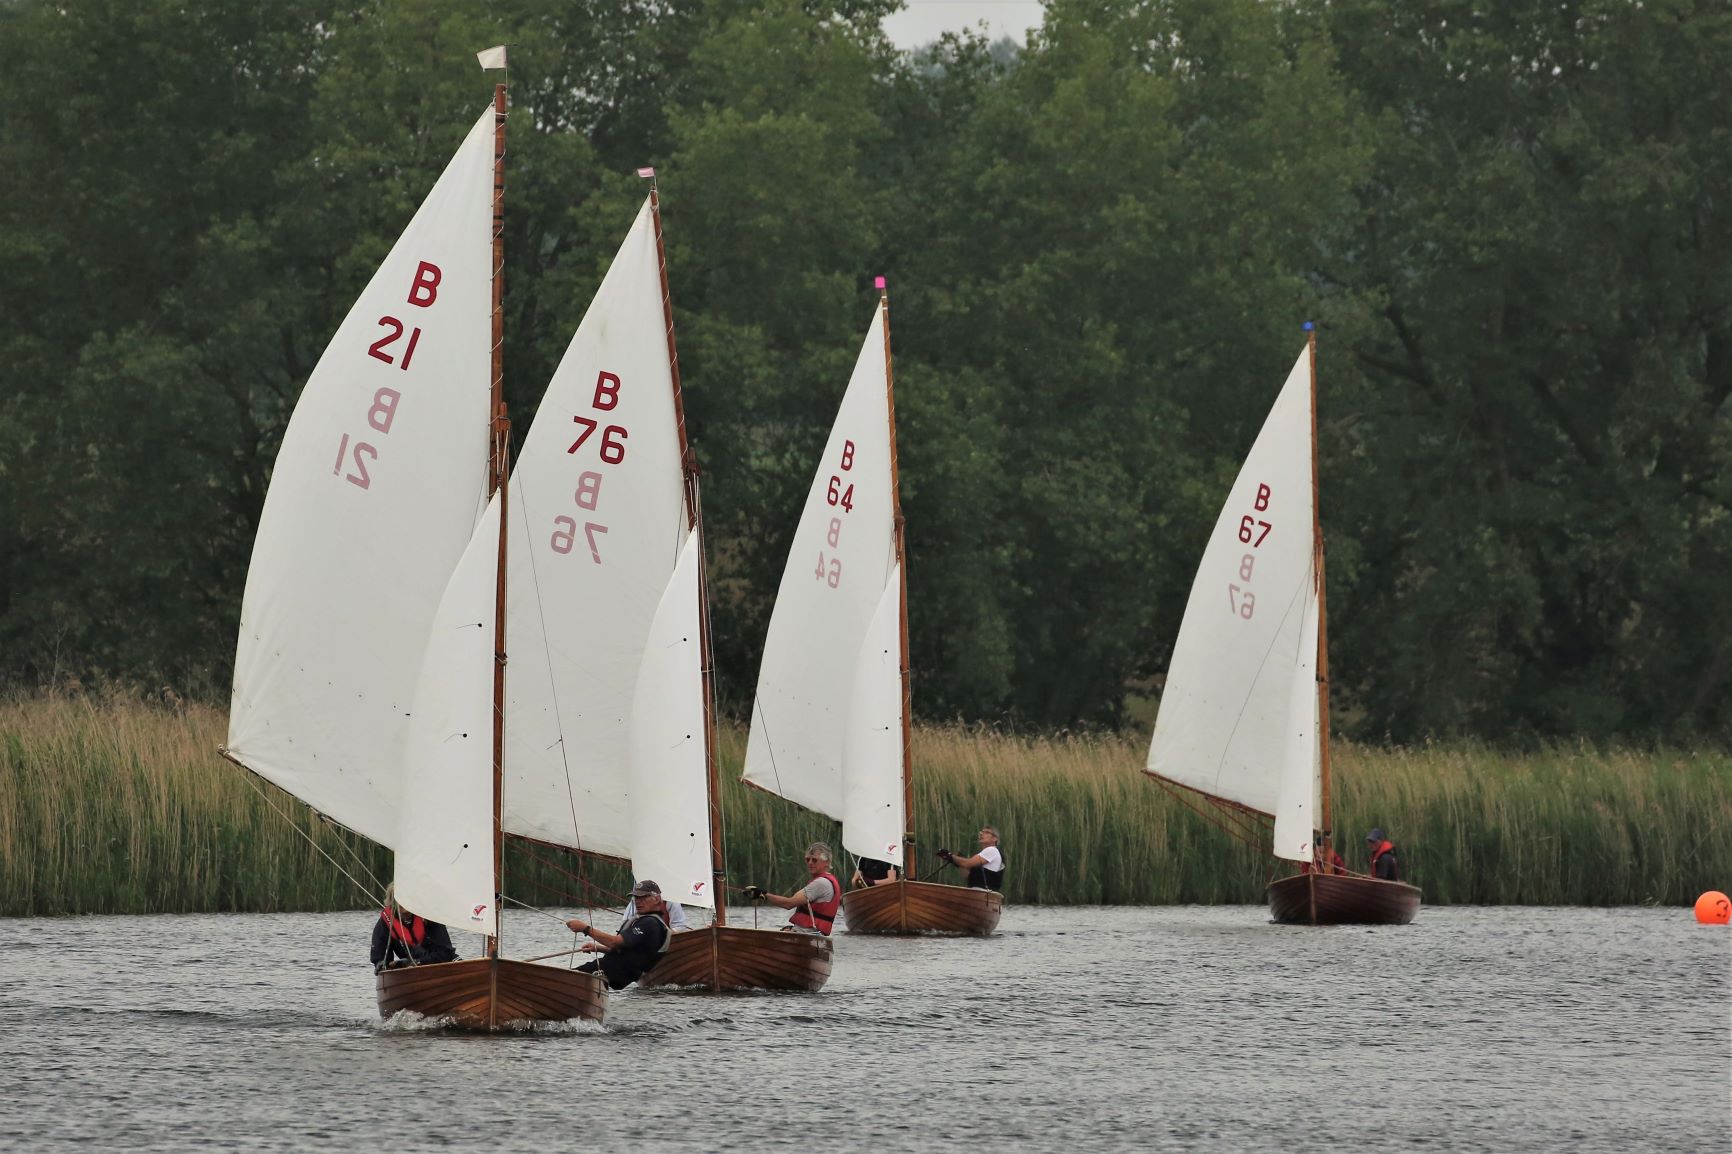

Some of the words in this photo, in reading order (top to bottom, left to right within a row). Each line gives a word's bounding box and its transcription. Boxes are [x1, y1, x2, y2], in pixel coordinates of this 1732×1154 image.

[407, 261, 442, 308] B
[368, 316, 421, 369] 21
[592, 371, 621, 411] B
[568, 416, 629, 464] 76
[841, 440, 854, 471] B
[827, 476, 854, 513] 64
[1254, 483, 1272, 512] B
[1239, 515, 1273, 548] 67
